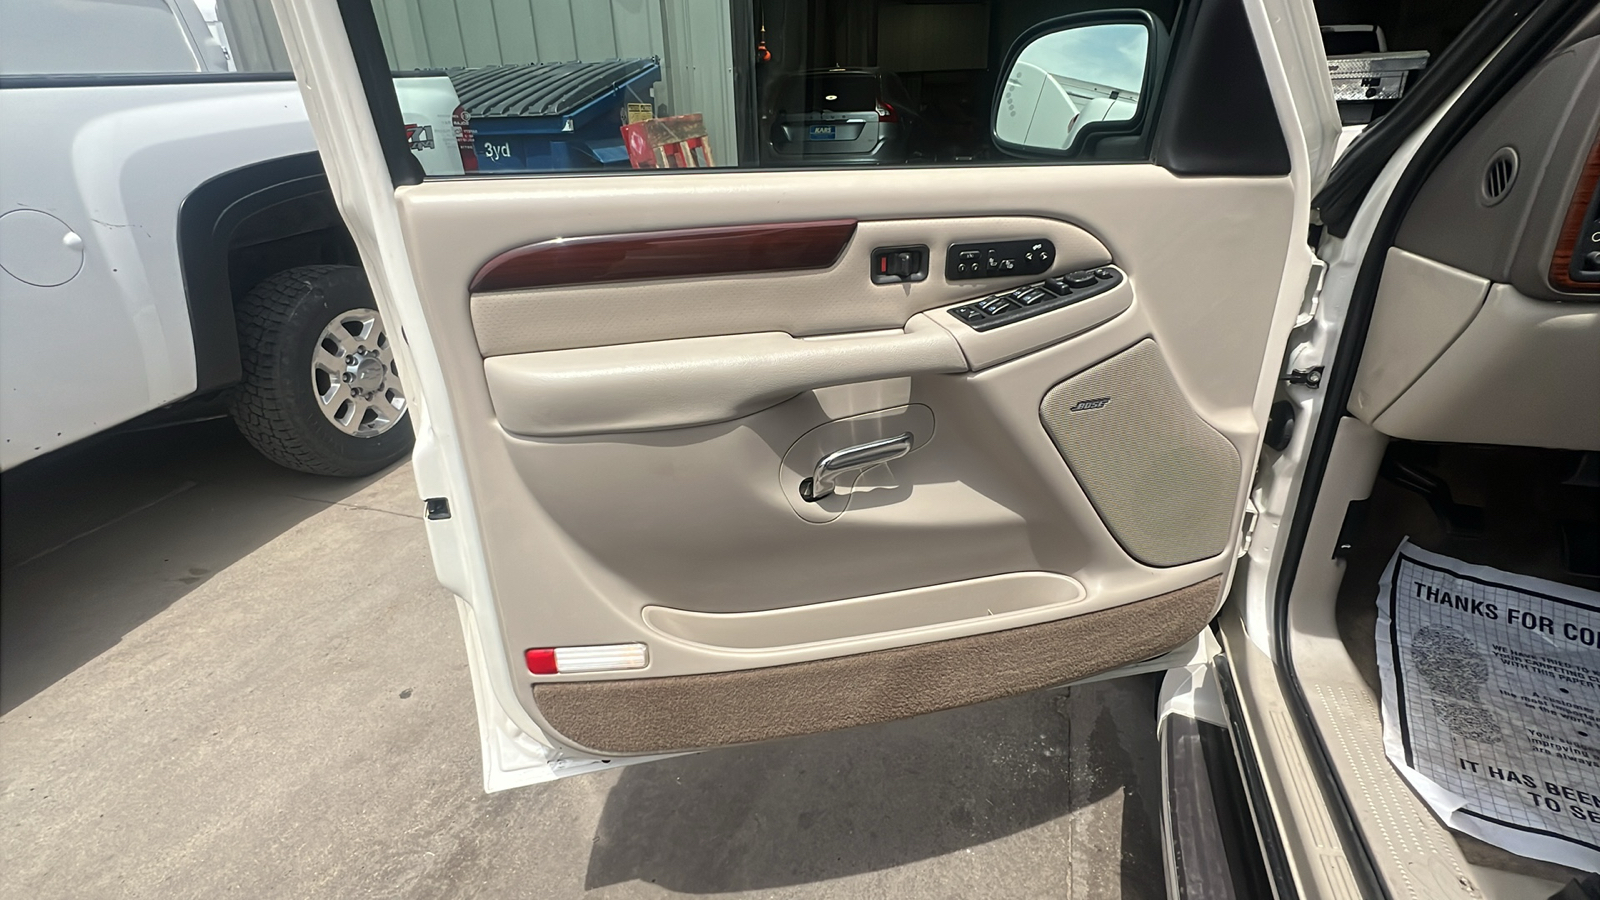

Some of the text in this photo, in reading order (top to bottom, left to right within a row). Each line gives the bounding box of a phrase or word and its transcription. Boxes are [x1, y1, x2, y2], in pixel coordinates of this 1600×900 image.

[484, 142, 511, 160] 3yd
[1071, 398, 1110, 411] BOSE
[1414, 581, 1600, 649] THANKS FOR CO
[1492, 644, 1508, 653] WE
[1510, 650, 1537, 659] HAVE
[1541, 657, 1571, 669] TRIED
[1575, 665, 1589, 674] TO
[1492, 651, 1522, 663] YOUR
[1525, 659, 1585, 679] CARPETING
[1500, 658, 1529, 670] WITH
[1531, 666, 1555, 679] THIS
[1559, 674, 1594, 688] PAPER
[1521, 696, 1548, 706] most
[1560, 713, 1593, 727] world
[1527, 728, 1554, 740] Your
[1532, 745, 1552, 755] are
[1556, 752, 1600, 768] always
[1460, 758, 1479, 773] IT
[1488, 766, 1537, 788] HAS
[1527, 791, 1600, 823] TO SE
